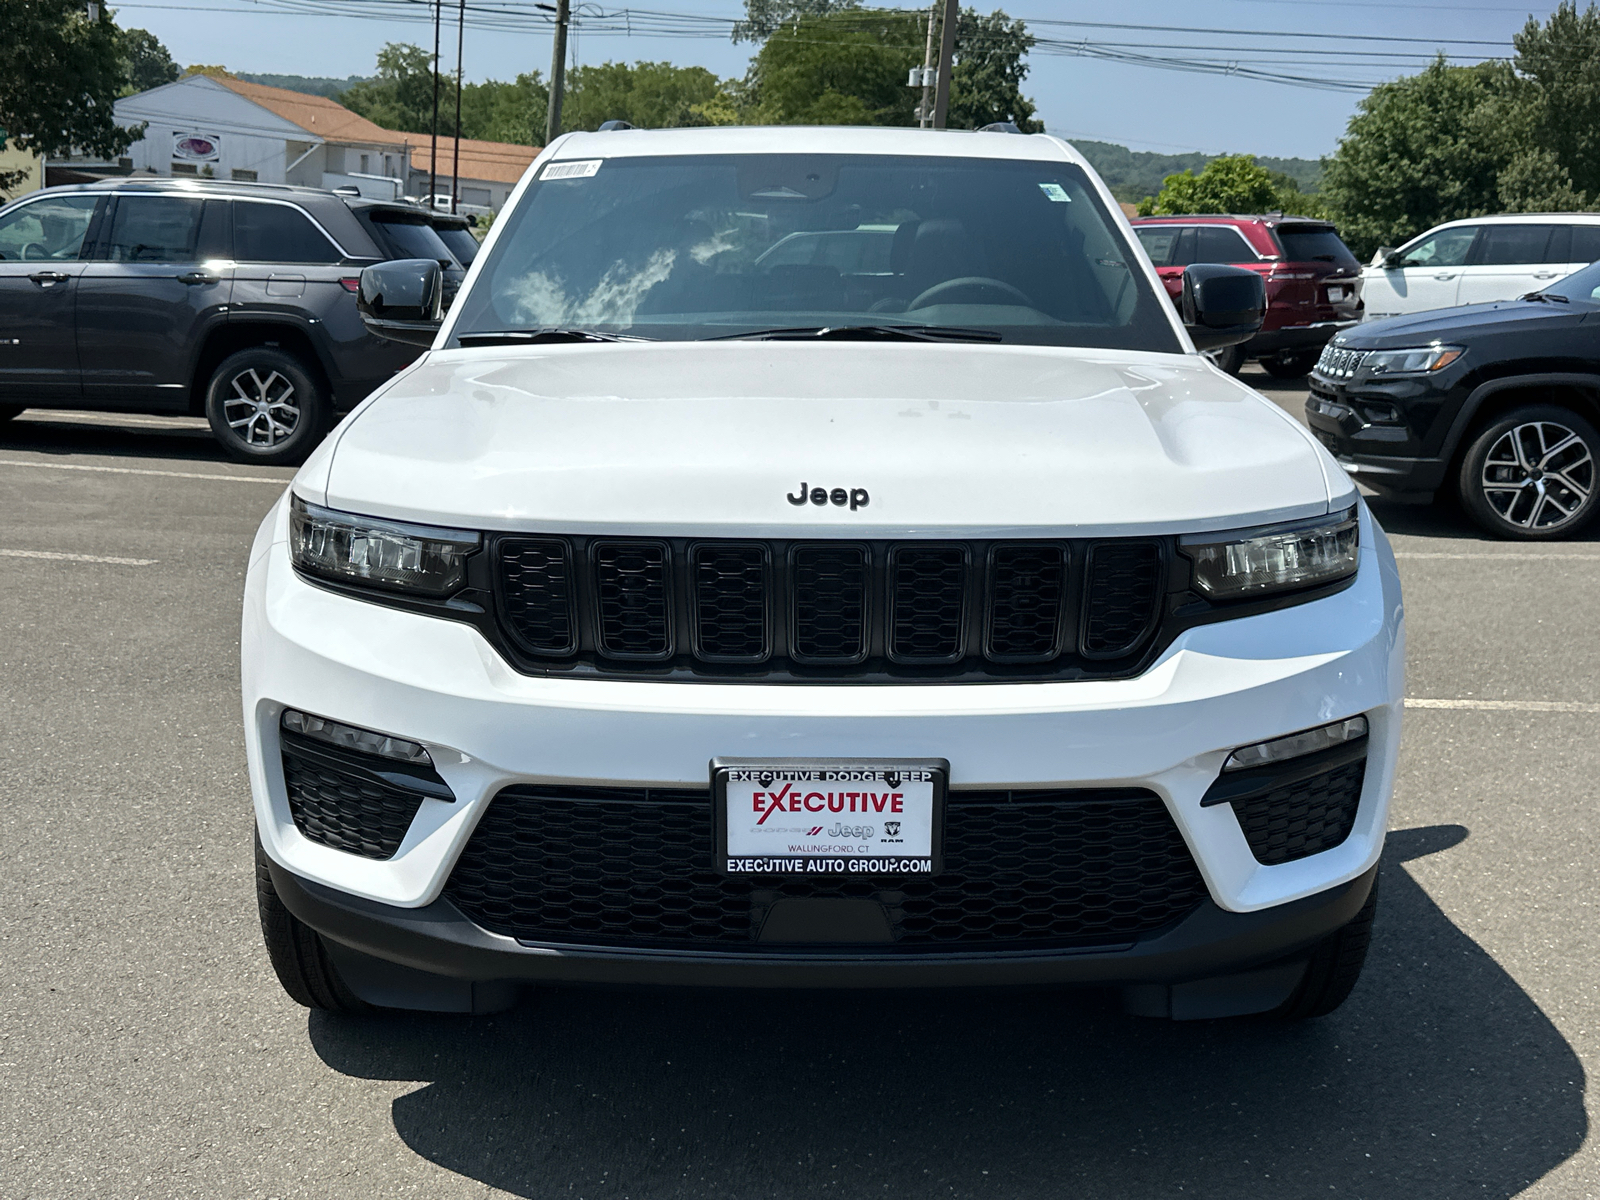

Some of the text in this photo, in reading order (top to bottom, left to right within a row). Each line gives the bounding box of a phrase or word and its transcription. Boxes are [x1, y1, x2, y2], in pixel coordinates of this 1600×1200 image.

[787, 482, 869, 511] Jeep
[728, 771, 932, 781] EXECUTIVE DODGE JEEP
[753, 783, 903, 825] EXECUTIVE
[827, 822, 874, 840] Jeep
[788, 844, 870, 854] WALLINGFORD, CT
[727, 859, 932, 872] EXECUTIVE AUTO GROUP.COM
